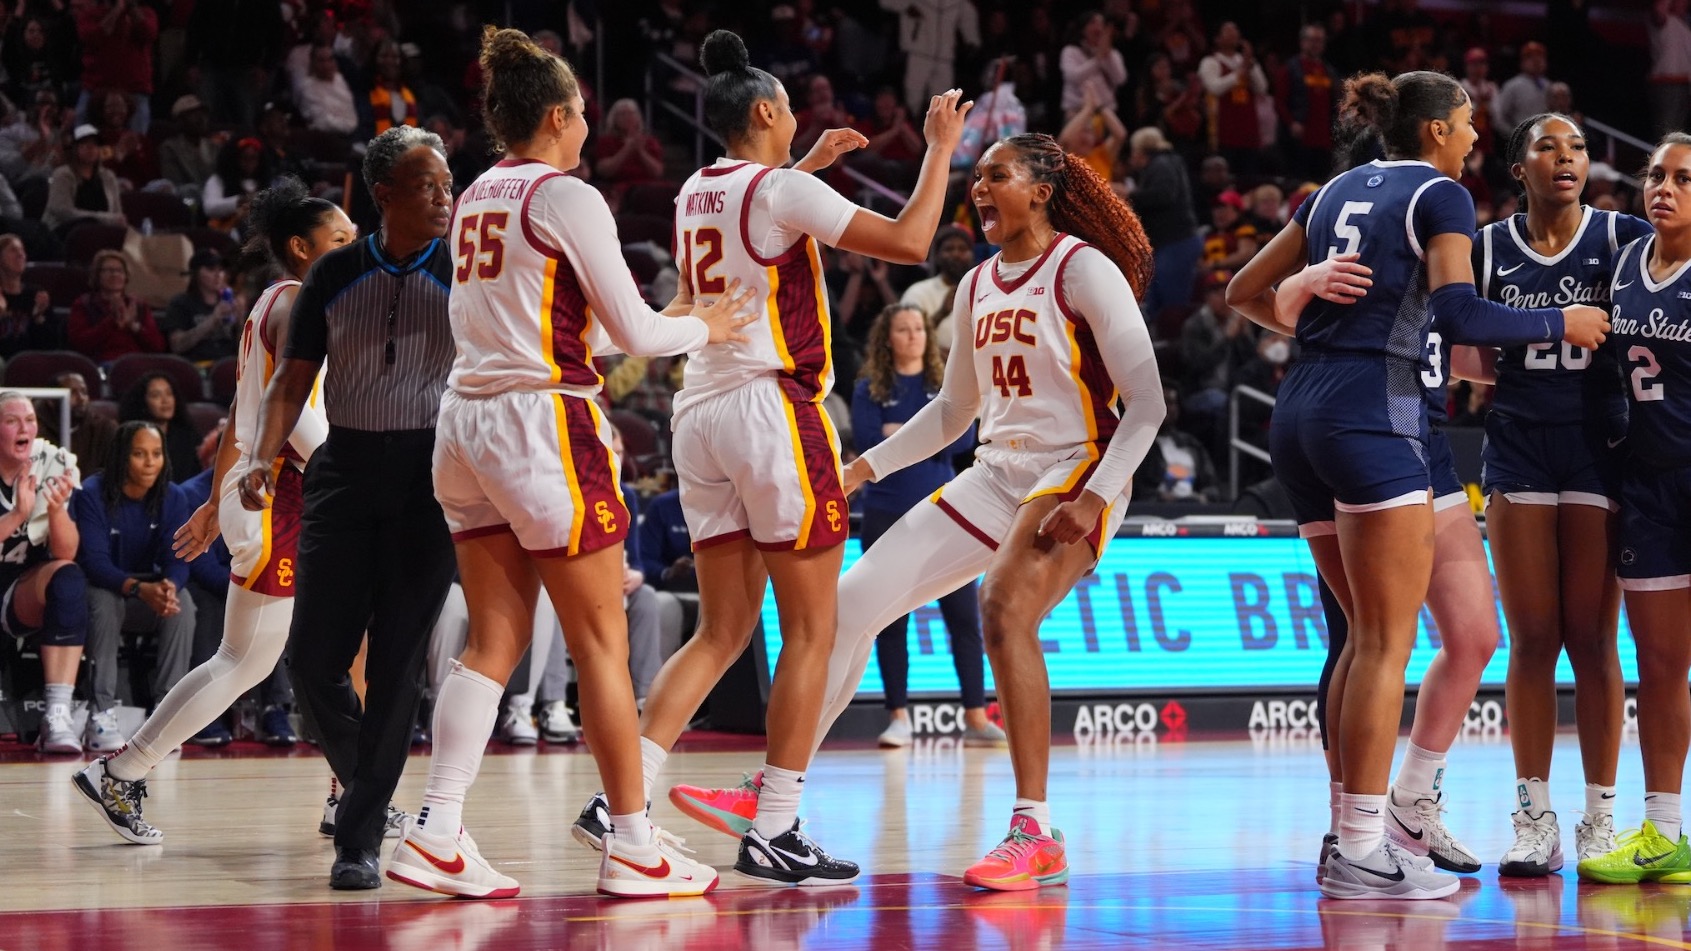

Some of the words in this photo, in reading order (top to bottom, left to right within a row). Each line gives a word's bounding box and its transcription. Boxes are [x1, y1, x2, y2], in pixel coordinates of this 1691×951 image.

[685, 190, 726, 217] WATKINS
[456, 210, 509, 284] 55
[1327, 201, 1374, 259] 5
[682, 226, 727, 297] 12
[1500, 284, 1552, 310] Penn
[1554, 275, 1610, 305] State
[974, 307, 1038, 350] USC
[1640, 308, 1691, 343] State
[991, 354, 1034, 398] 44
[1627, 345, 1665, 402] 2
[1073, 703, 1158, 732] ARCO
